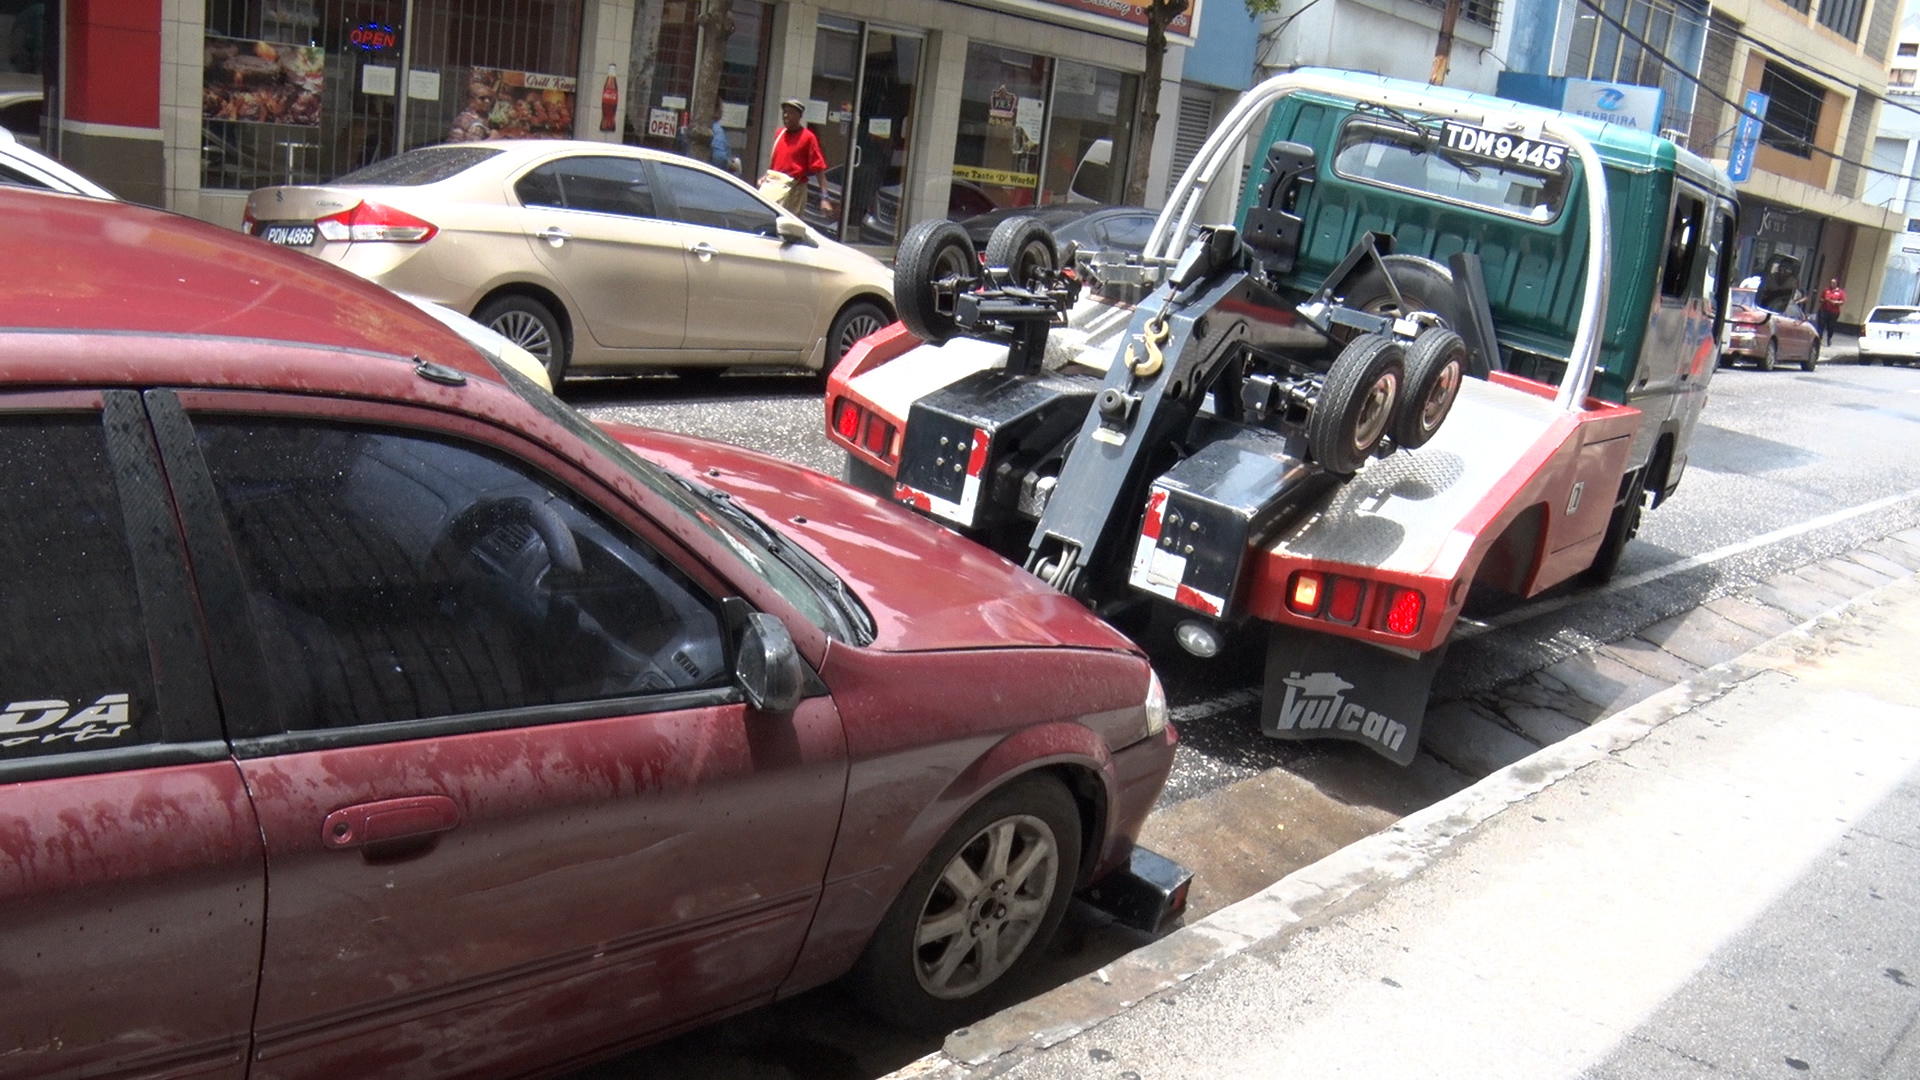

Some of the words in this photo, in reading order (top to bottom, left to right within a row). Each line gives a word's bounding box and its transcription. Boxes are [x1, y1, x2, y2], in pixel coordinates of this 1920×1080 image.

[350, 29, 396, 47] OPEN
[526, 73, 550, 88] Grill
[650, 120, 676, 136] OPEN
[1446, 124, 1564, 170] TDM9445
[971, 170, 995, 180] Taste
[1277, 672, 1407, 751] Vulcan
